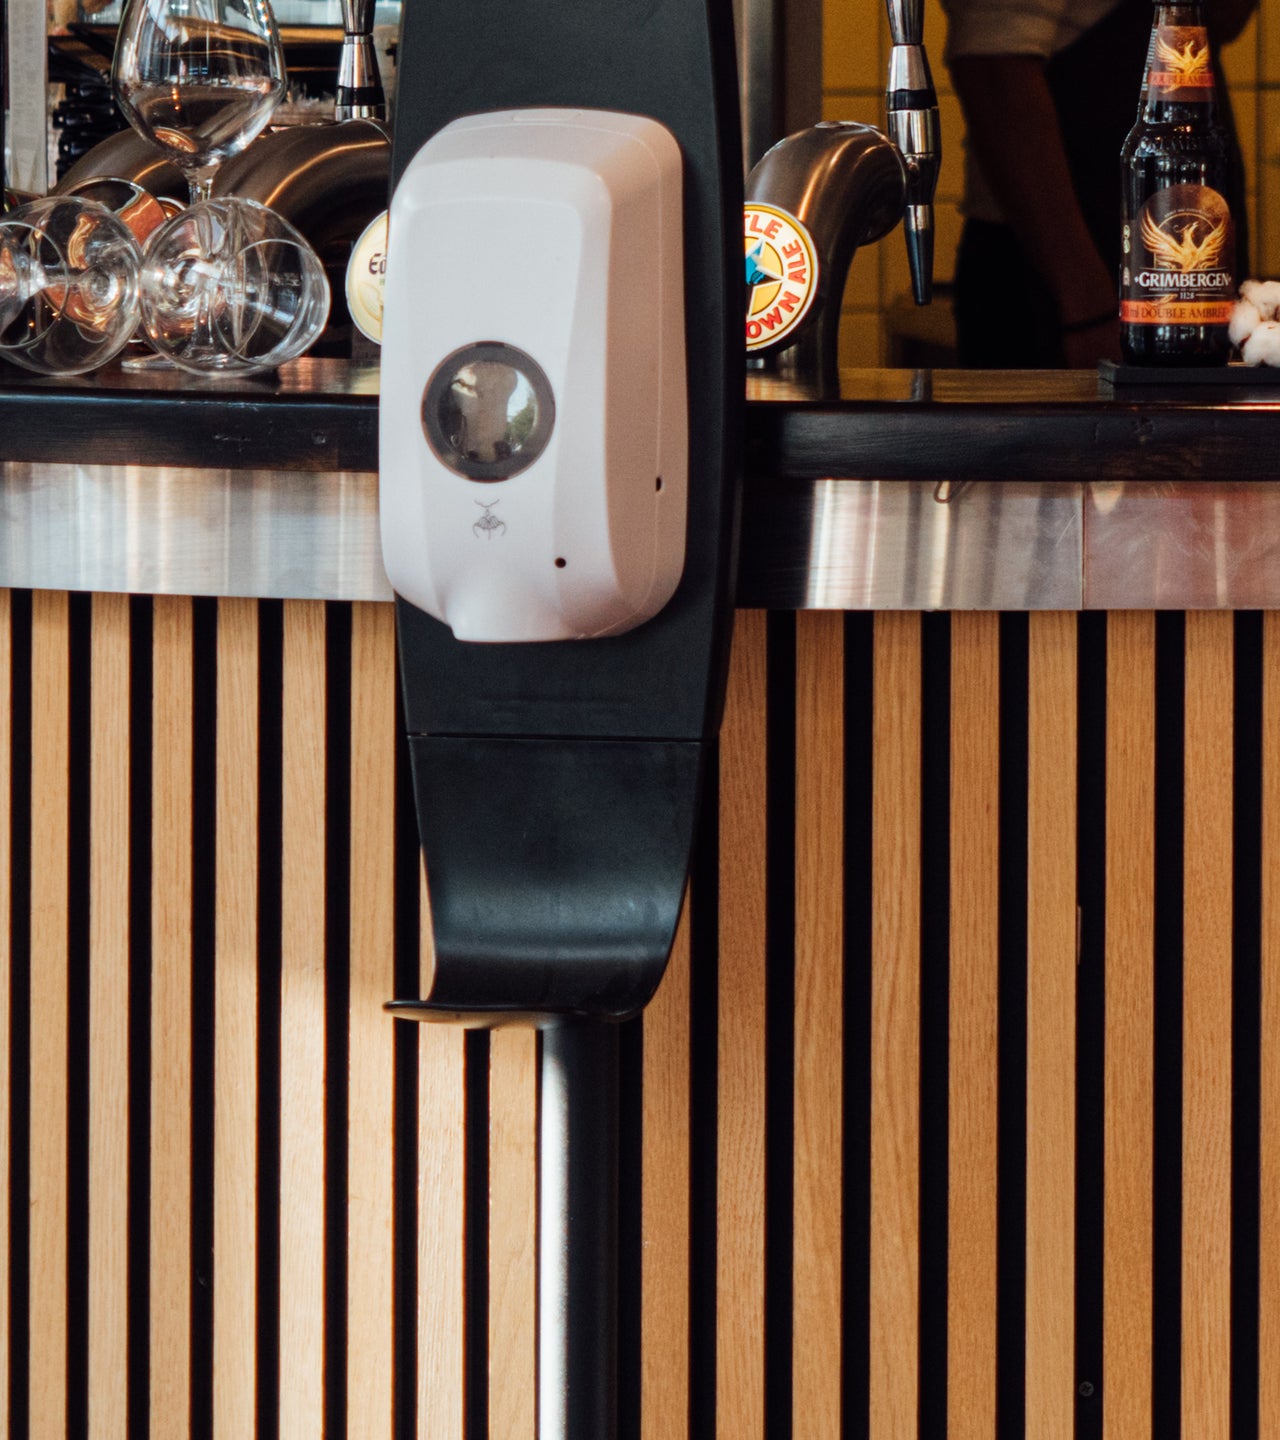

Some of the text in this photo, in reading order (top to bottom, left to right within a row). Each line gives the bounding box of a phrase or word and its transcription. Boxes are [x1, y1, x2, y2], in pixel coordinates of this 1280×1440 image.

[781, 239, 807, 285] ALE
[1138, 272, 1229, 287] GRIMBERGEN
[1141, 307, 1186, 319] DOUBLE
